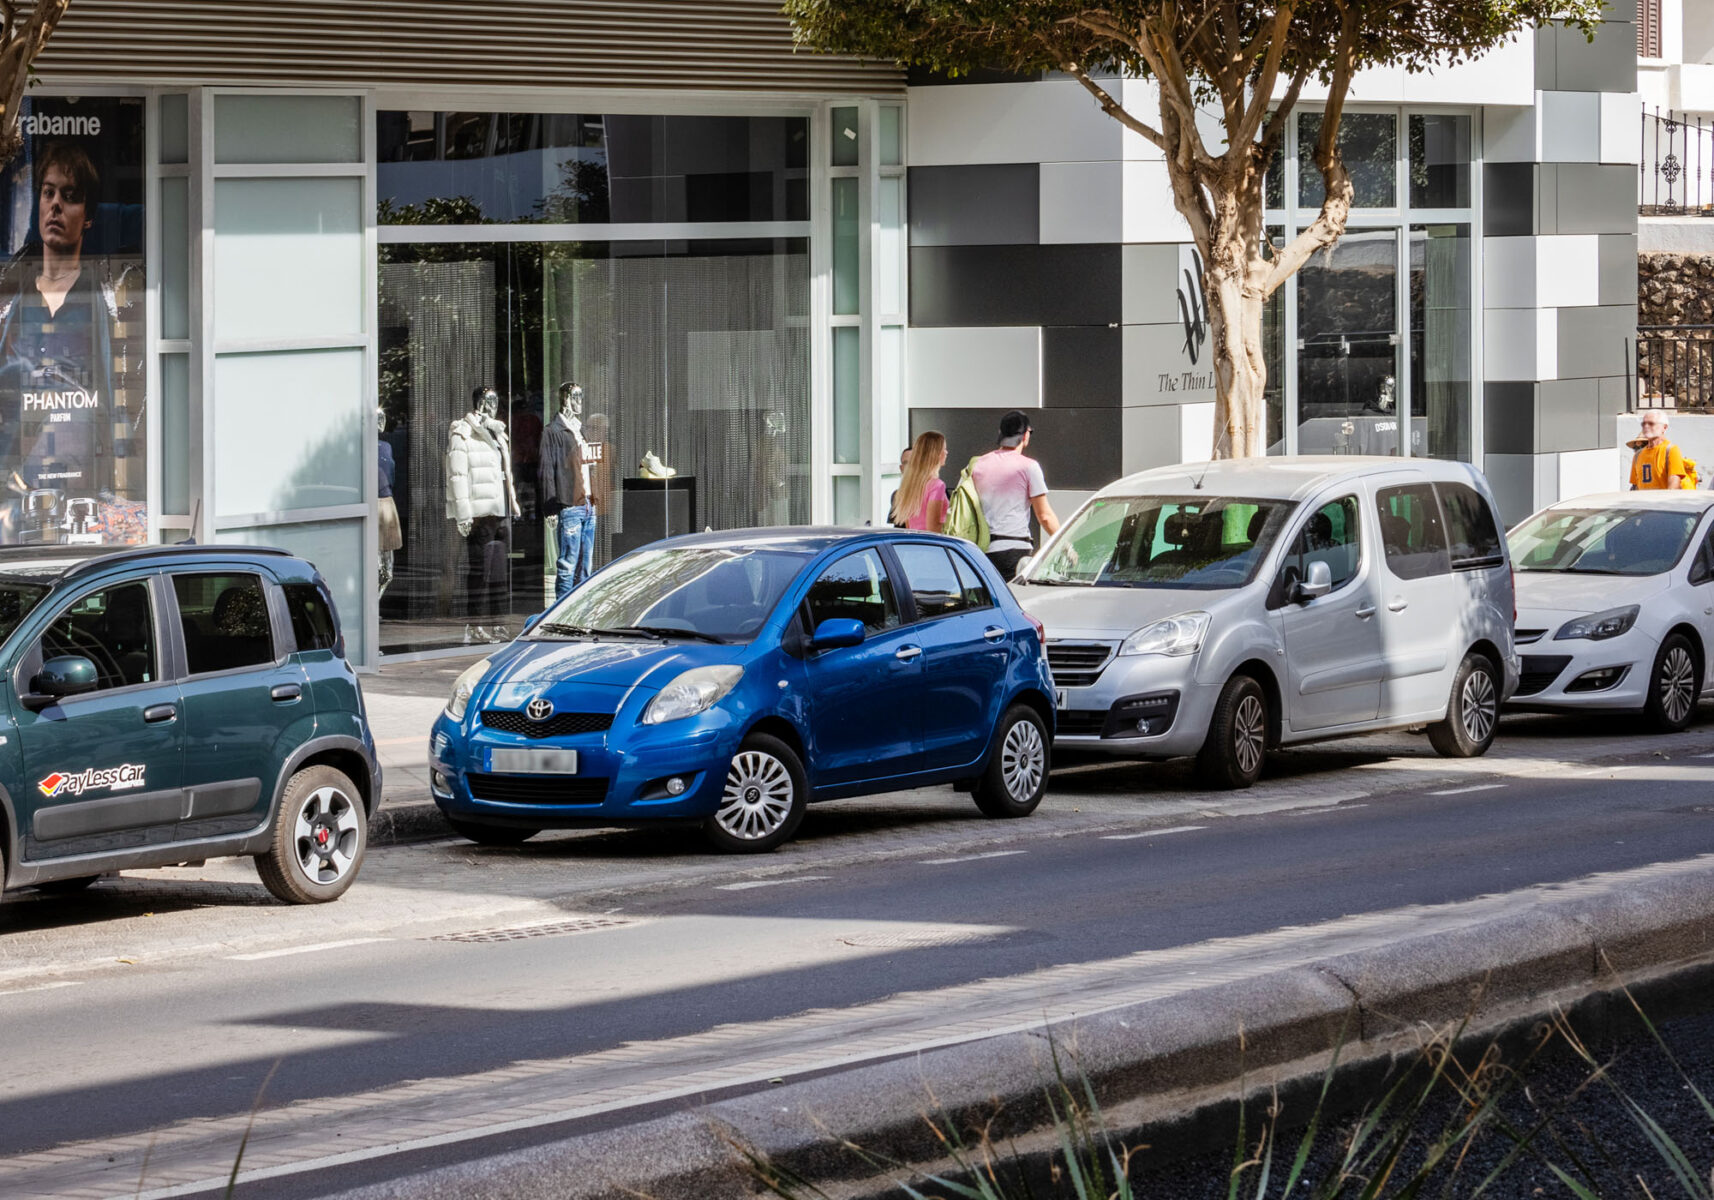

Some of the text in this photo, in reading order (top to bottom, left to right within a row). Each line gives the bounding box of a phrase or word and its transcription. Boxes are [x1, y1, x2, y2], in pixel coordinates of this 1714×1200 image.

[18, 112, 101, 135] rabanne
[1158, 373, 1178, 392] The
[1181, 371, 1205, 391] Thin
[23, 390, 98, 411] PHANTOM
